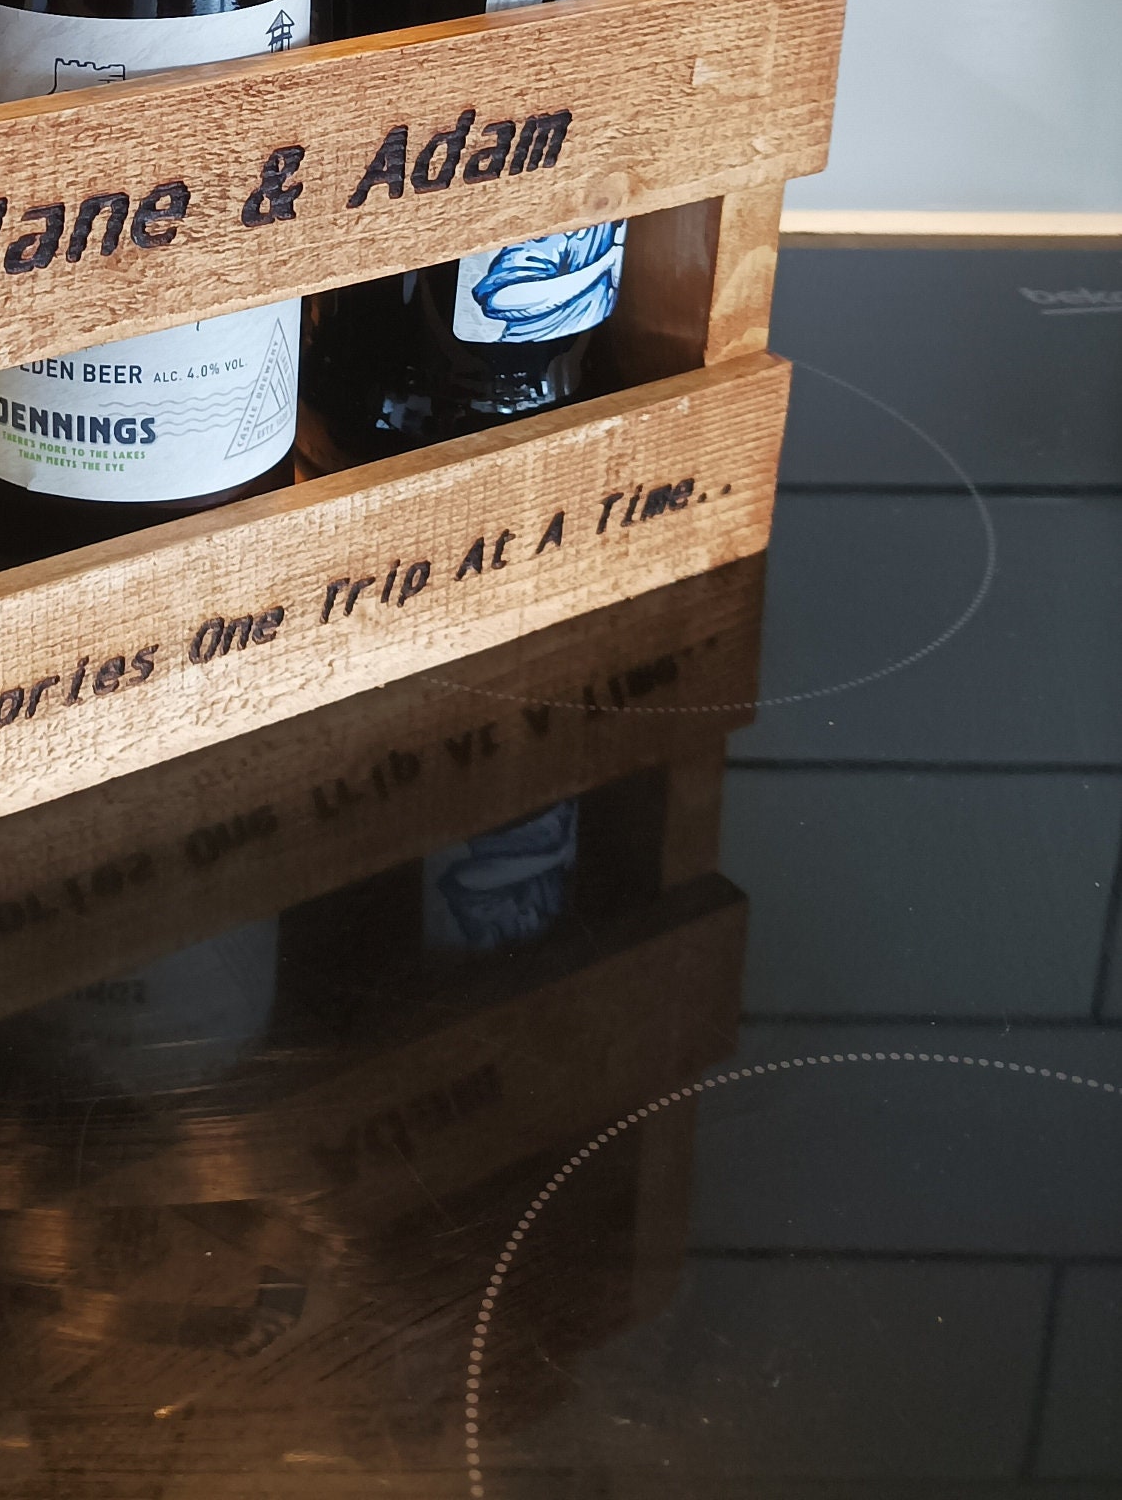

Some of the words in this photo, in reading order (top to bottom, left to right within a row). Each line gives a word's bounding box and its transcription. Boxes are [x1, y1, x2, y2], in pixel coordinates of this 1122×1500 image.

[241, 144, 305, 228] &
[347, 108, 573, 209] Adam
[83, 363, 143, 384] BEER
[153, 371, 183, 383] ALC.
[187, 363, 220, 379] 4.0%
[224, 357, 248, 372] VOL.
[2, 430, 35, 449] THERE'S
[39, 441, 68, 456] MORE
[72, 447, 86, 457] TO
[90, 449, 109, 460] THE
[113, 450, 146, 460] LAKES
[18, 448, 42, 463] THAN
[46, 456, 77, 469] MEETS
[82, 461, 101, 471] THE
[105, 462, 125, 472] EYE
[188, 604, 284, 665] One
[319, 557, 430, 625] Trip
[454, 527, 516, 581] At
[536, 509, 566, 555] A
